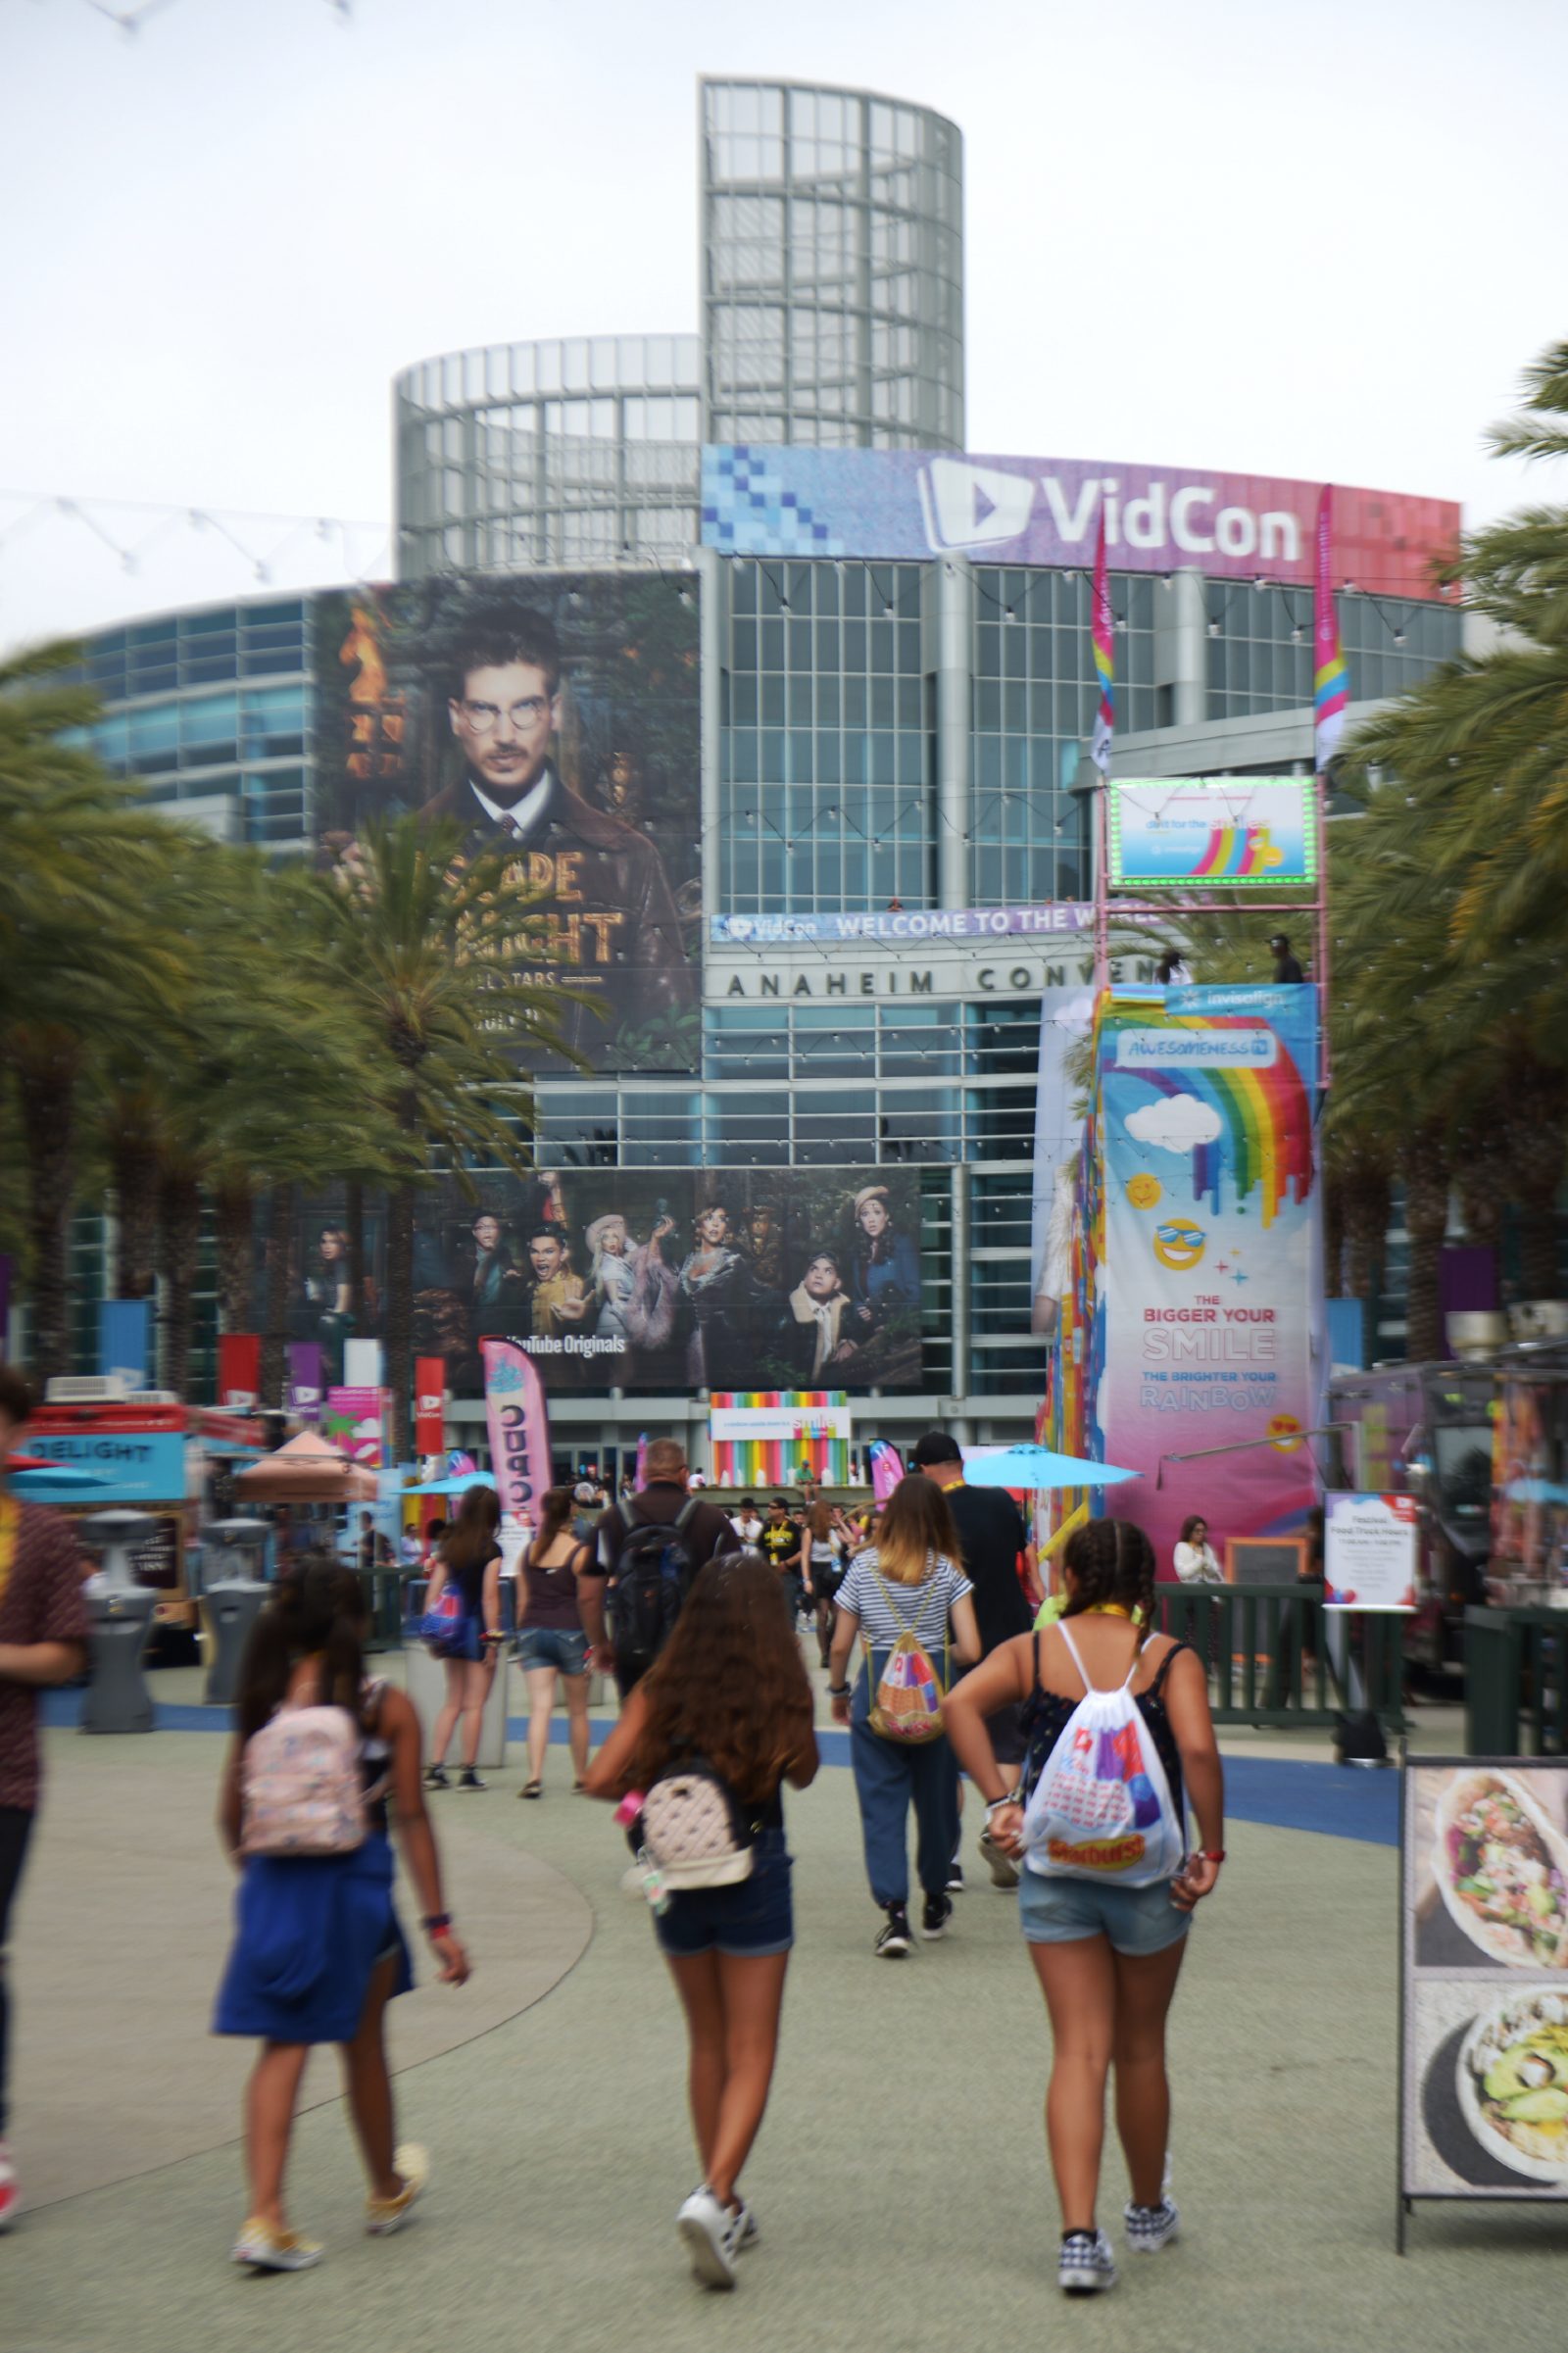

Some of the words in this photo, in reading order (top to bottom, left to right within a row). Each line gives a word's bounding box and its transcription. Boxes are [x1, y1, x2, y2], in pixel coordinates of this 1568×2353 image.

[1040, 477, 1301, 562] VidCon
[837, 914, 968, 938] WELCOME
[974, 911, 1011, 932] TO
[1017, 907, 1066, 930] THE
[728, 970, 932, 997] ANAHEIM
[979, 959, 1153, 991] CONVEN
[1207, 988, 1287, 1008] invisalign
[1194, 1295, 1220, 1305] THE
[1143, 1308, 1216, 1323] BIGGER
[1223, 1308, 1276, 1323] YOUR
[564, 1334, 626, 1359] Originals
[1142, 1328, 1276, 1361] SMILE
[1142, 1371, 1166, 1382] THE
[1172, 1371, 1238, 1382] BRIGHTER
[1241, 1371, 1277, 1382] YOUR
[1140, 1386, 1277, 1412] RAINBOW
